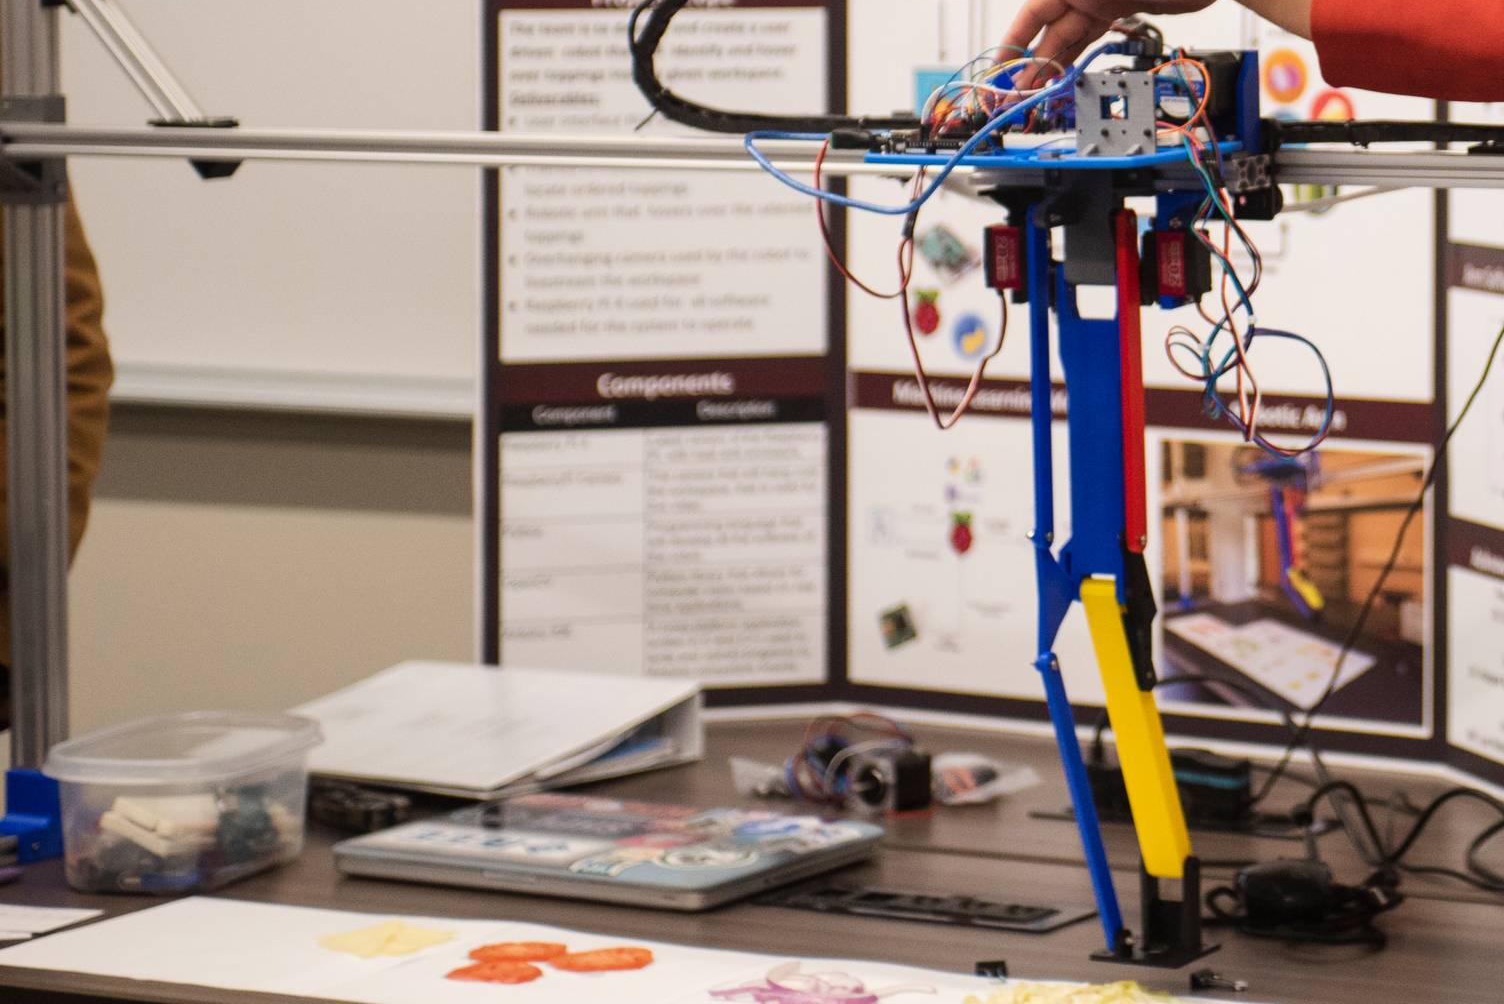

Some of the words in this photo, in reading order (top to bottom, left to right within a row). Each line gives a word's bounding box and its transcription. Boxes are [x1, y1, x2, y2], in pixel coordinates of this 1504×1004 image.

[598, 372, 735, 400] Components
[970, 388, 1033, 412] Learnin
[1230, 398, 1300, 429] Rbotic
